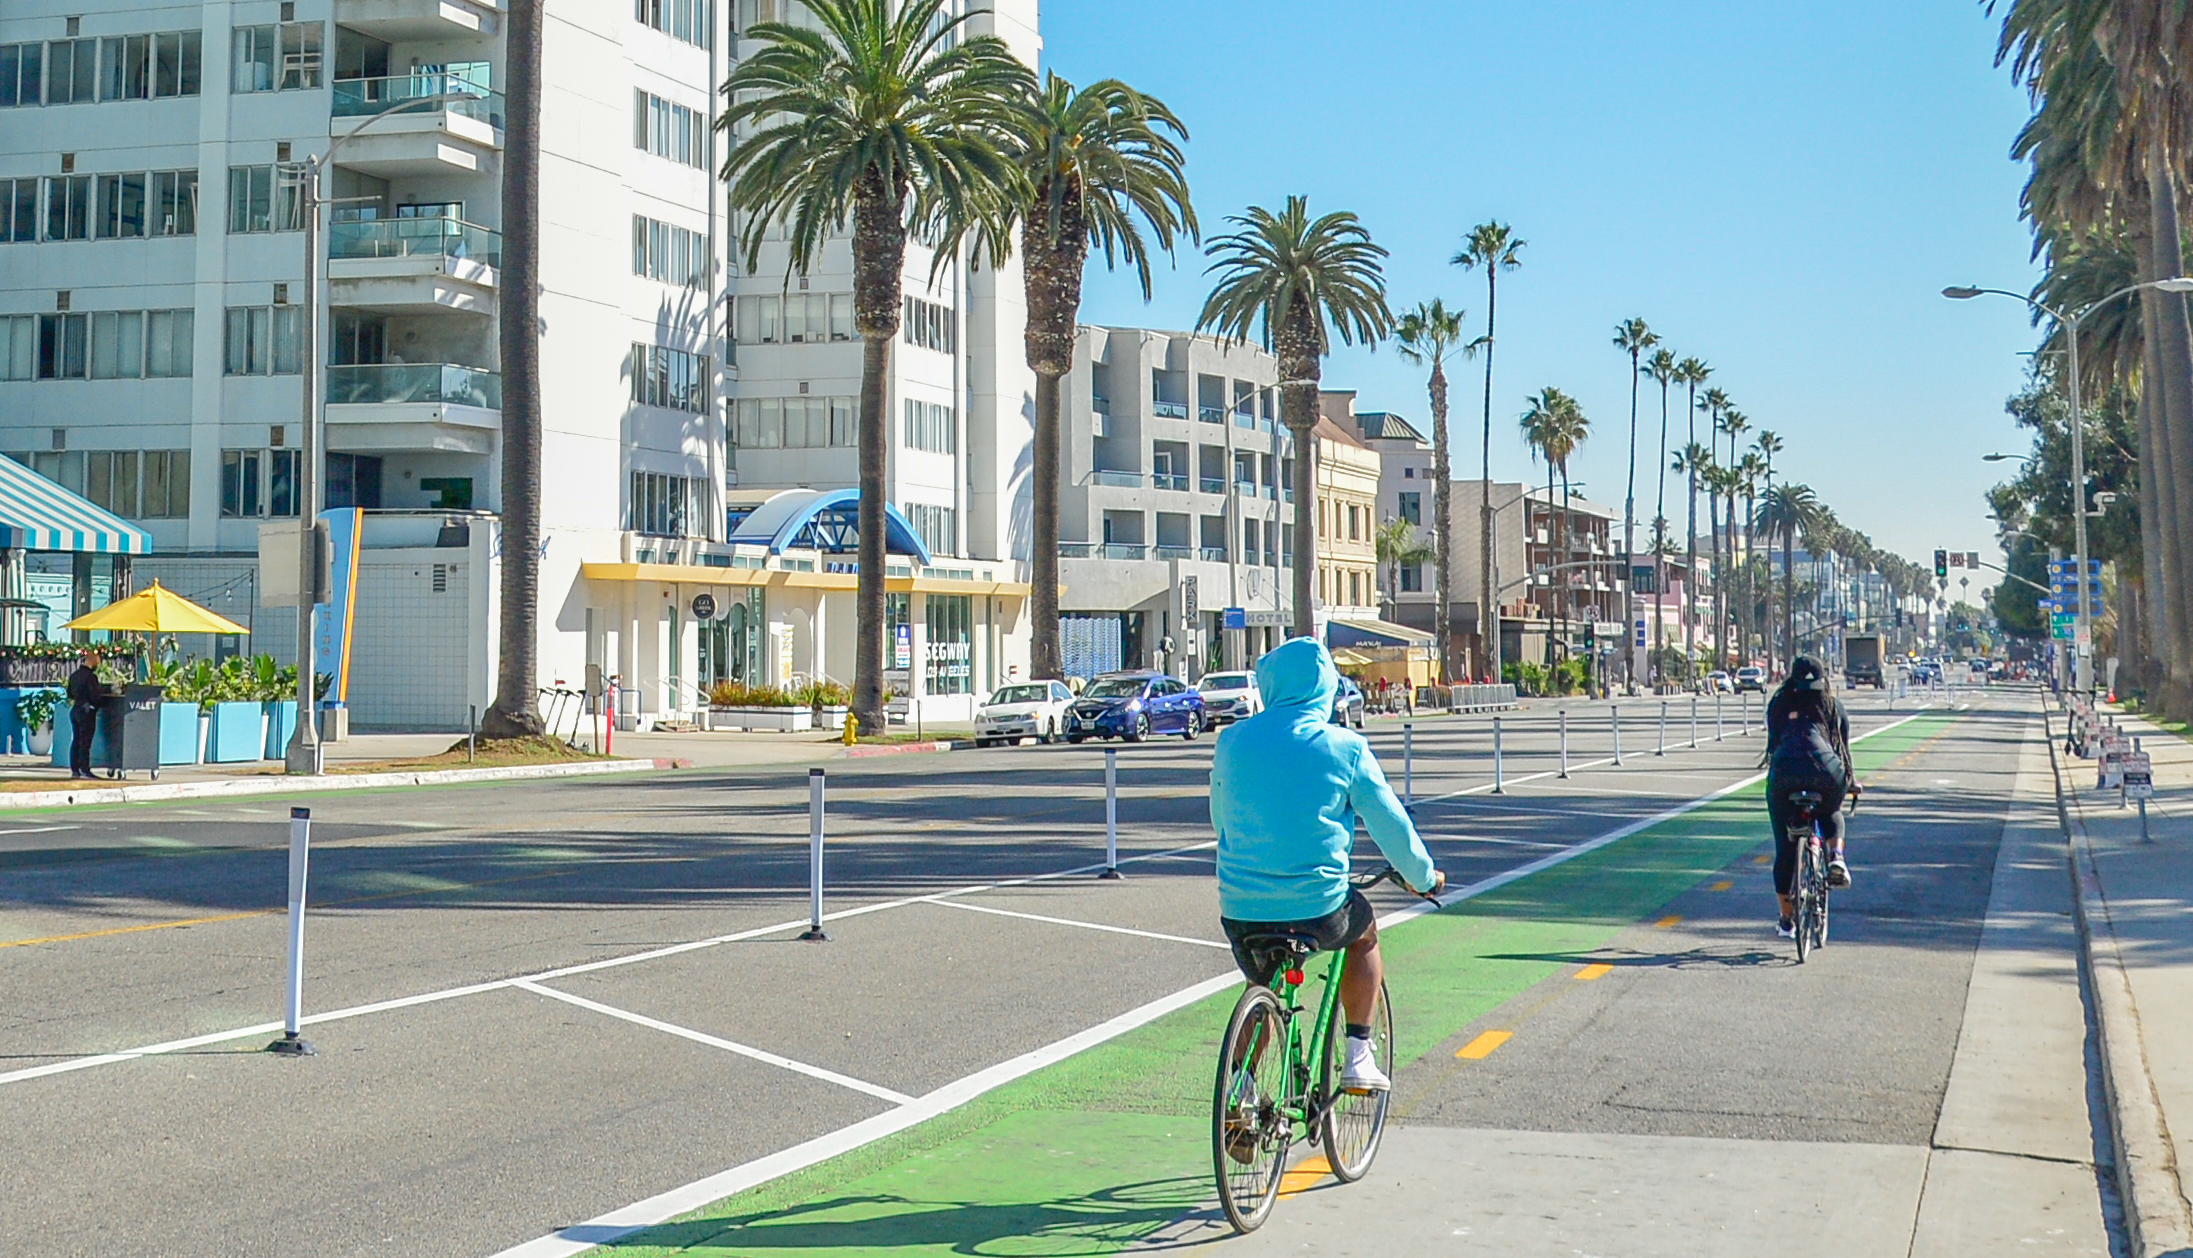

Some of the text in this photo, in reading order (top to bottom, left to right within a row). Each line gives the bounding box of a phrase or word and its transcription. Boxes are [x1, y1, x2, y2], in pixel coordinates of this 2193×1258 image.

[1186, 577, 1197, 621] PARK
[1246, 613, 1292, 623] HOTEL
[925, 641, 970, 661] SEGWAY
[938, 664, 970, 677] ANGELES
[129, 701, 157, 710] VALET
